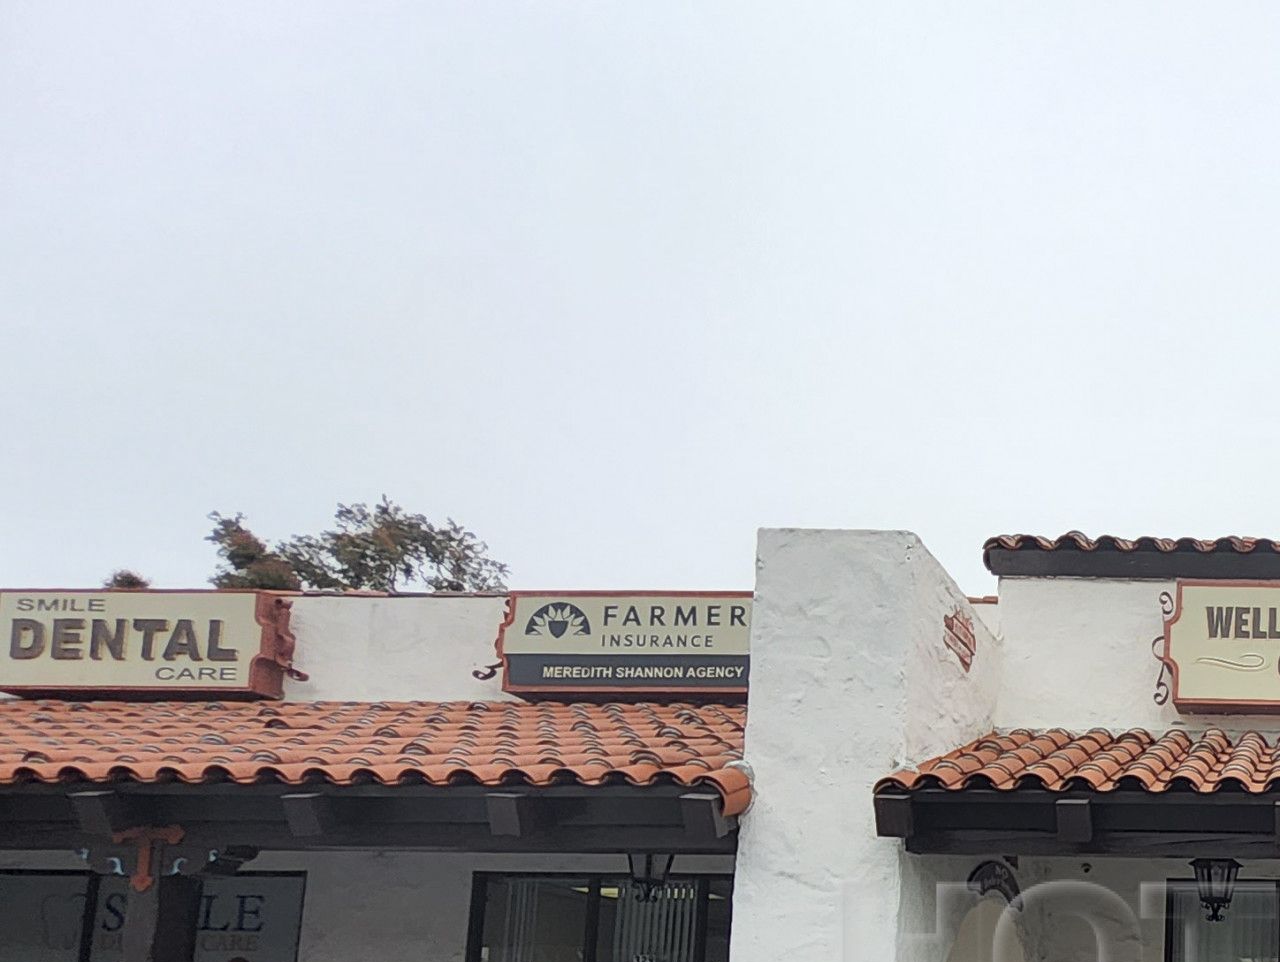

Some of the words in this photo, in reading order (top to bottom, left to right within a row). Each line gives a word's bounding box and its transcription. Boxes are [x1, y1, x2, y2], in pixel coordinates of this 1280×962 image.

[16, 598, 106, 612] SMILE
[602, 605, 748, 627] FARMER
[9, 618, 240, 662] DENTAL
[601, 634, 714, 648] INSURANCE
[155, 667, 238, 681] CARE
[542, 665, 612, 679] MEREDITH
[615, 665, 683, 679] SHANNON
[686, 665, 744, 679] AGENCY
